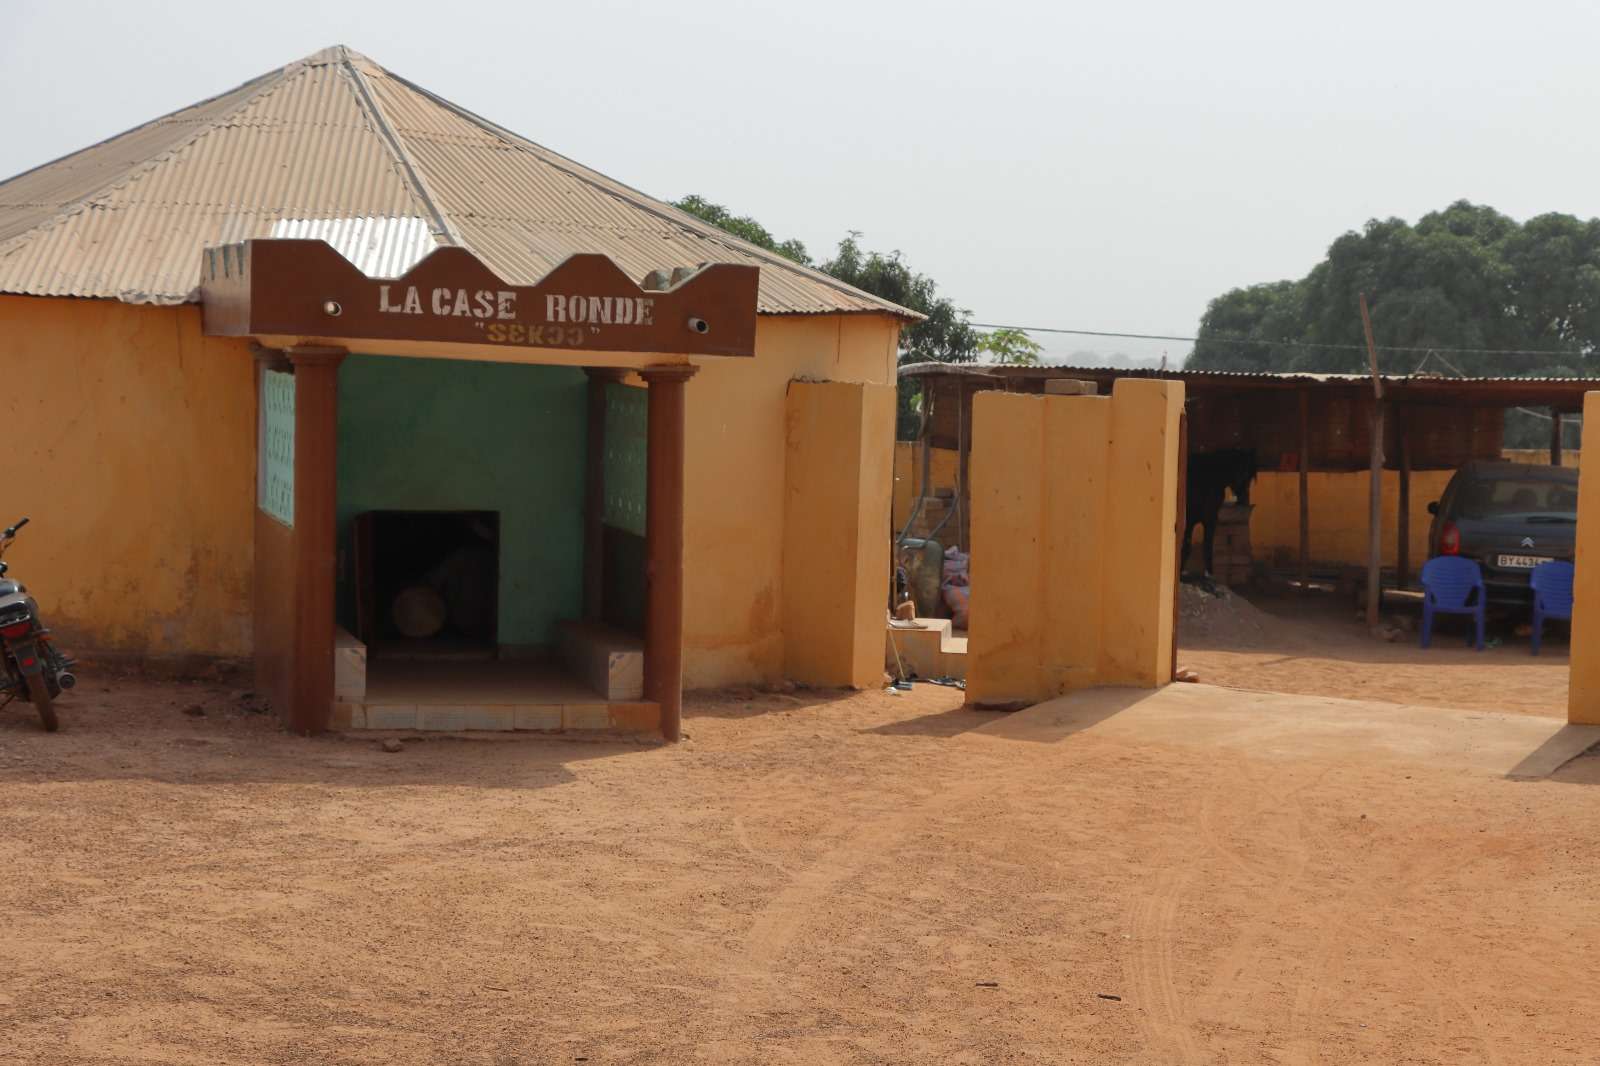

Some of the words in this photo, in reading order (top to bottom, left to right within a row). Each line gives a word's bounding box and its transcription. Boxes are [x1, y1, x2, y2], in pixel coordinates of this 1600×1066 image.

[378, 285, 424, 315] LA
[431, 287, 518, 321] CASE
[544, 293, 655, 326] RONDE
